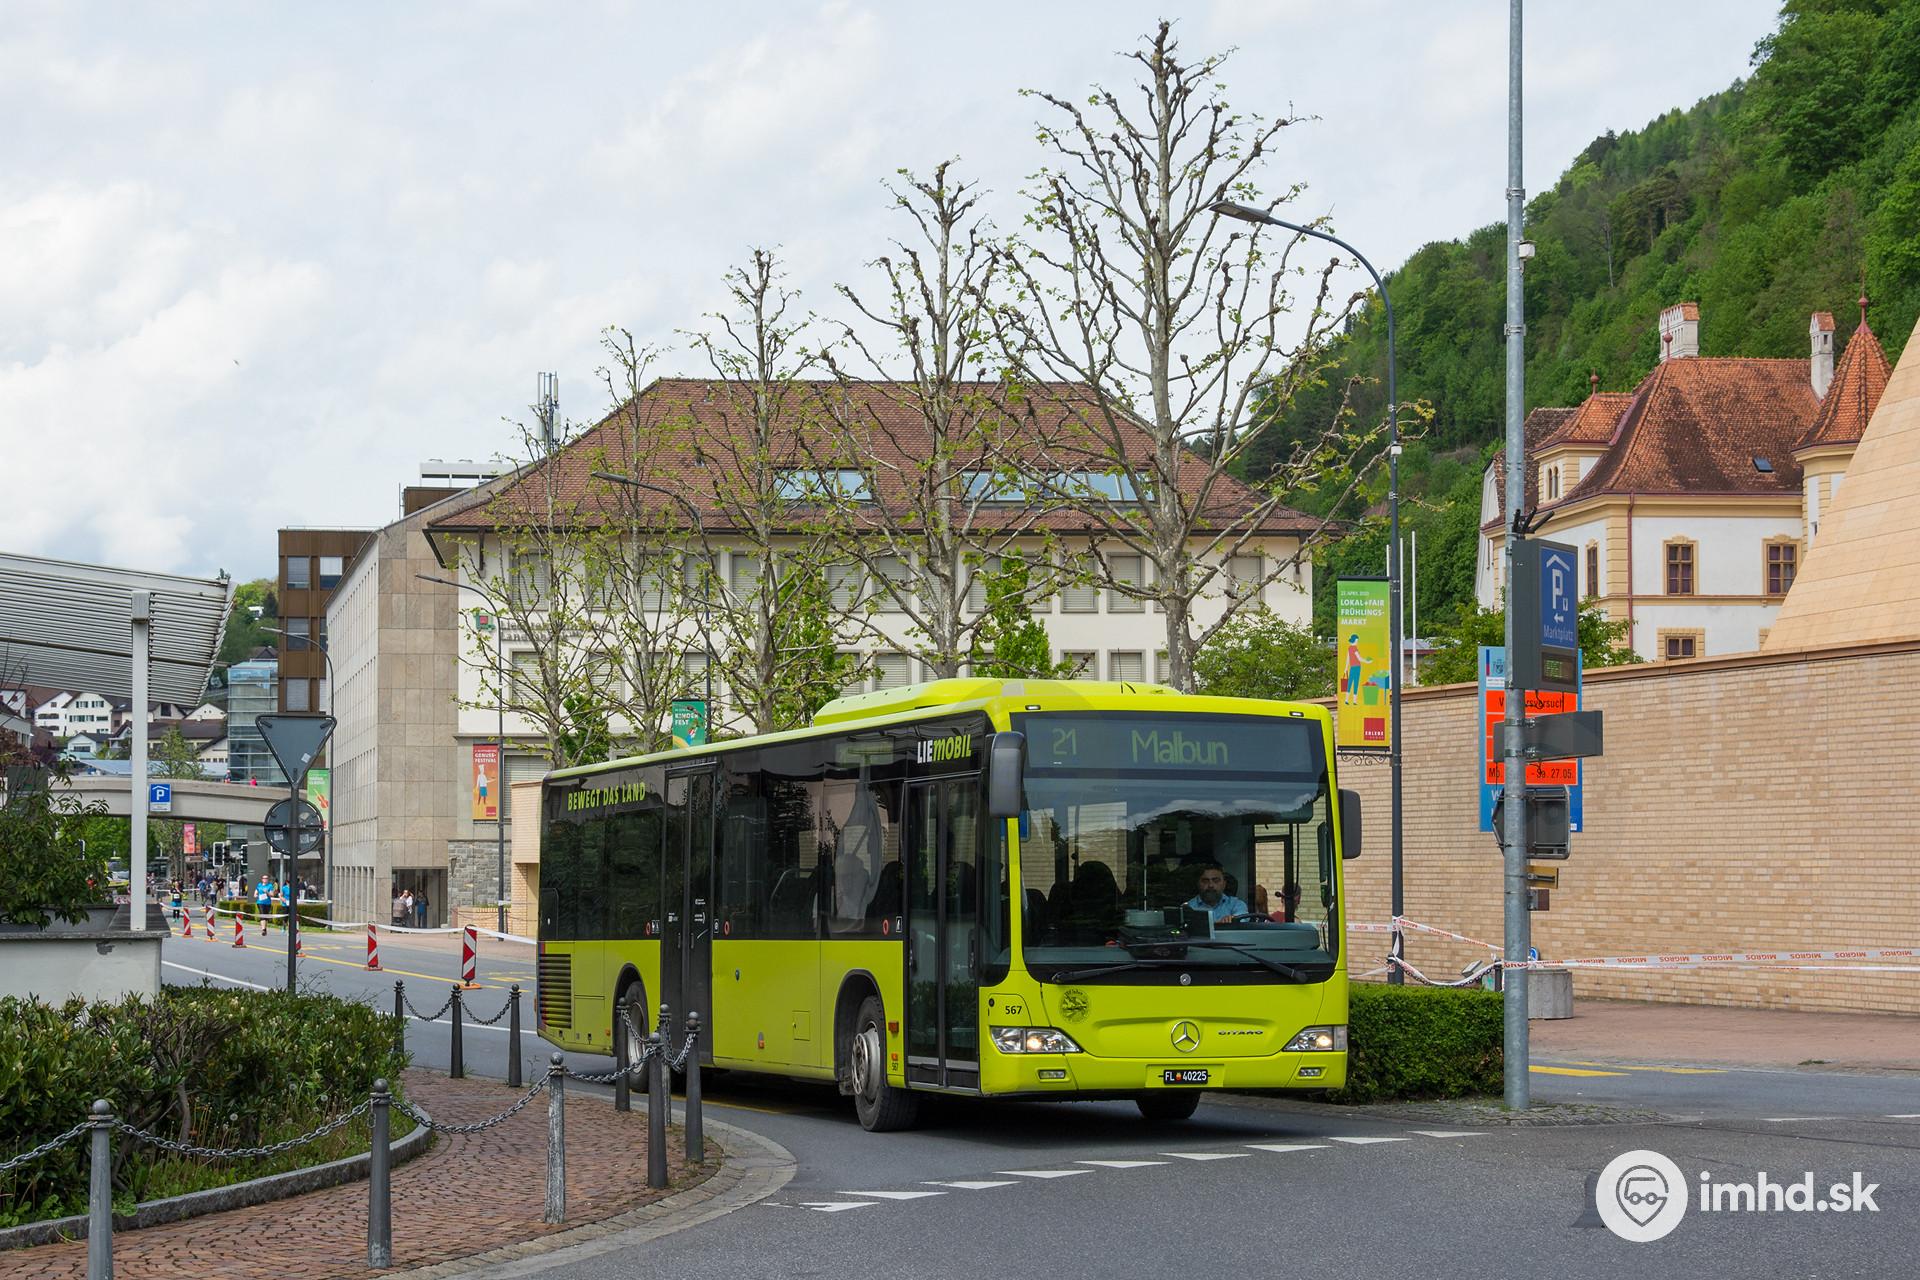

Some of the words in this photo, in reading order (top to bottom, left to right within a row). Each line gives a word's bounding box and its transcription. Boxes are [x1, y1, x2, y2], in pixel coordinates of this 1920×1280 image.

[1552, 568, 1563, 609] P
[1543, 624, 1574, 642] Marktplatz
[1052, 728, 1077, 755] 21
[1131, 729, 1229, 765] Malbun
[567, 788, 600, 811] BEWEGT
[603, 785, 619, 806] DAS
[622, 782, 646, 803] LAND
[1745, 953, 1777, 961] MIGROS
[1879, 949, 1912, 957] MIGROS
[1005, 1005, 1023, 1015] 567
[1165, 1071, 1175, 1081] FL
[1182, 1070, 1207, 1081] 40225
